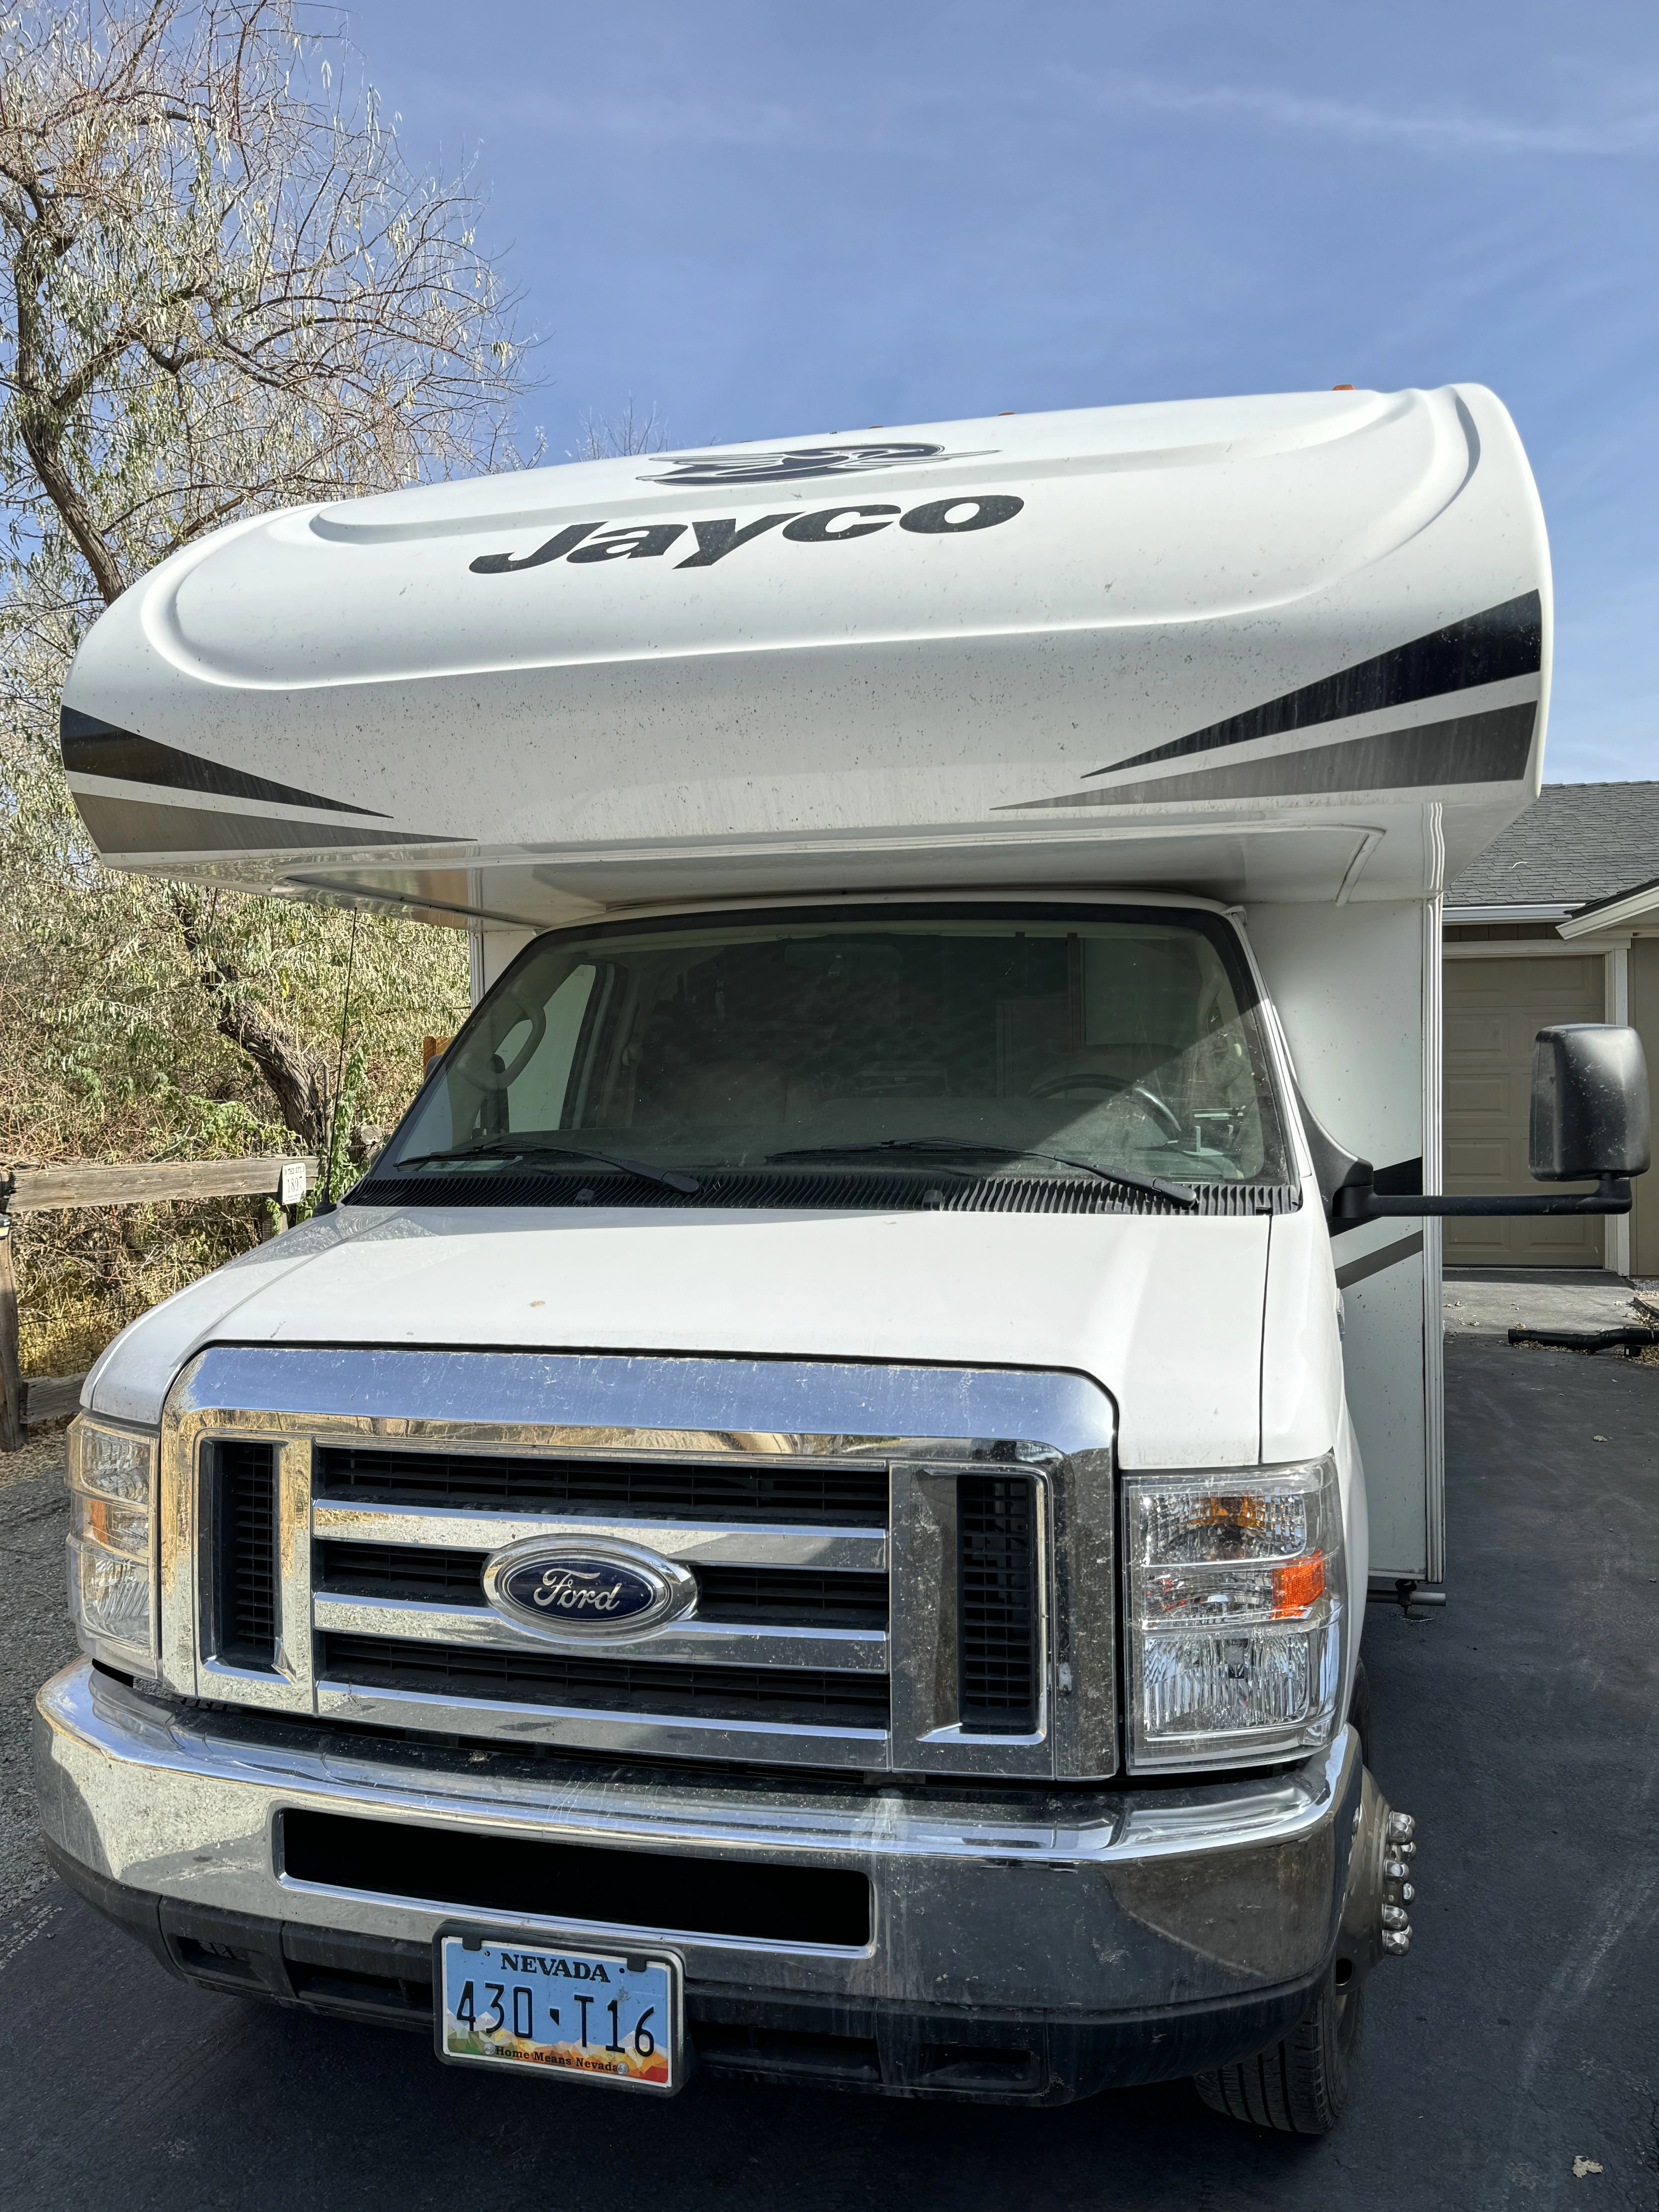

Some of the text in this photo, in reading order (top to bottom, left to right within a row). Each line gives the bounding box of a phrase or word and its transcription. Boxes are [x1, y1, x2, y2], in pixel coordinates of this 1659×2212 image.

[469, 495, 1024, 574] Jayco
[287, 1176, 302, 1193] 1897
[533, 1568, 622, 1611] Ford
[500, 1952, 611, 1983] NEVADA
[456, 1980, 654, 2057] 430 T16
[496, 2045, 619, 2072] Home Means Nevada
